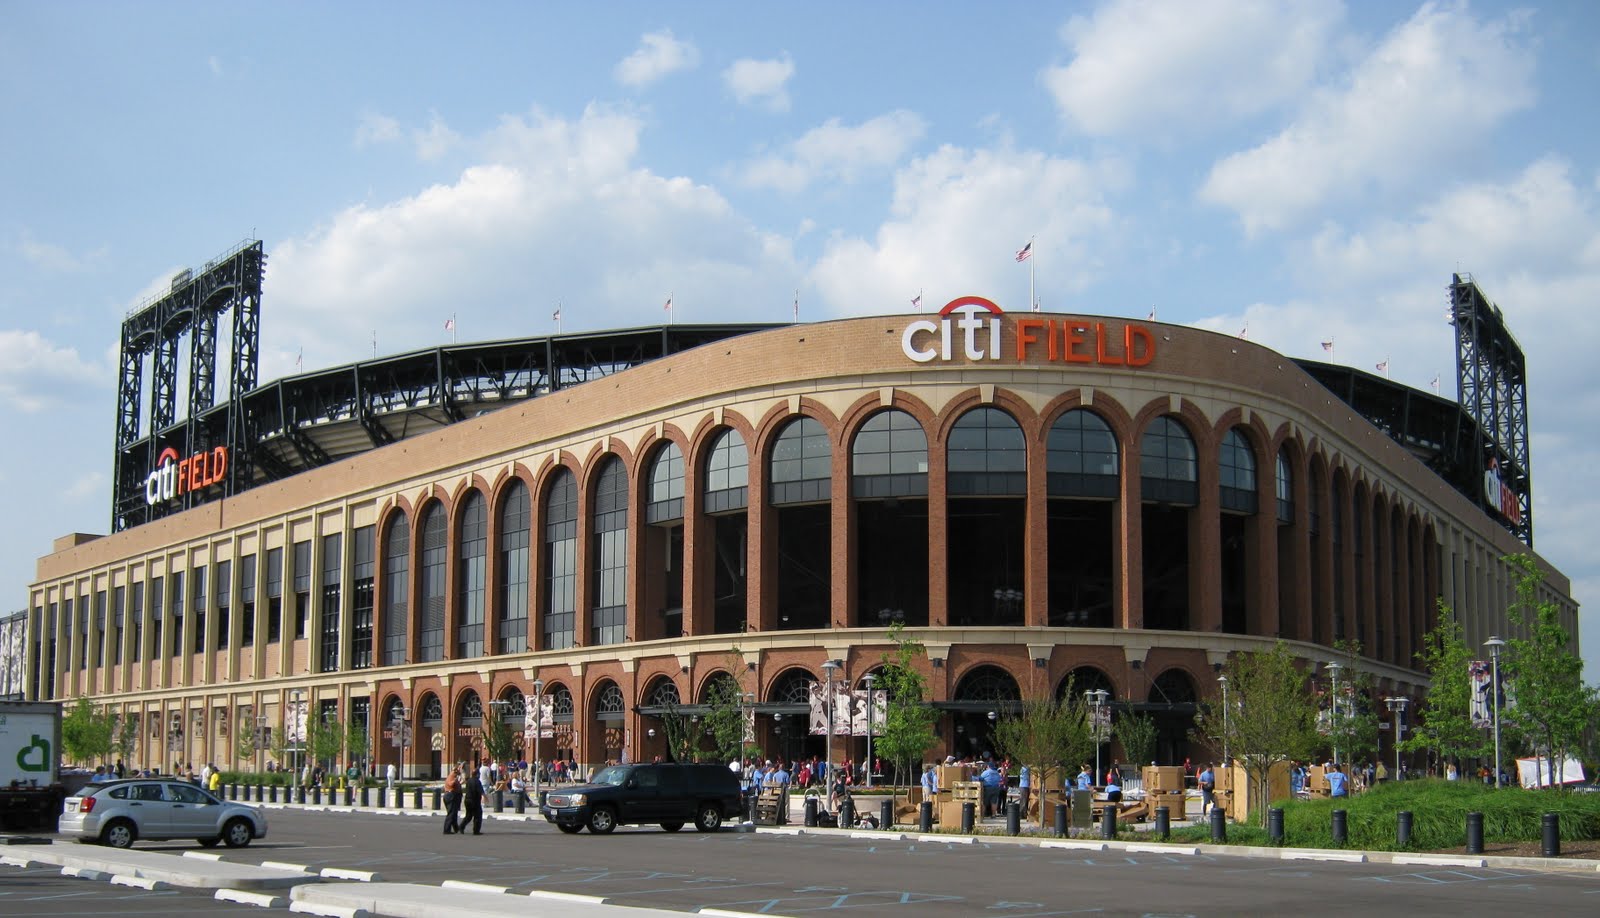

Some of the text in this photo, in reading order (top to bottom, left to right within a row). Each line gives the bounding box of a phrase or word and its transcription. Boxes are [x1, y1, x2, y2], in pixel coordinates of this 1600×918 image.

[902, 297, 1155, 366] citi FIELD
[178, 446, 228, 495] FIELD
